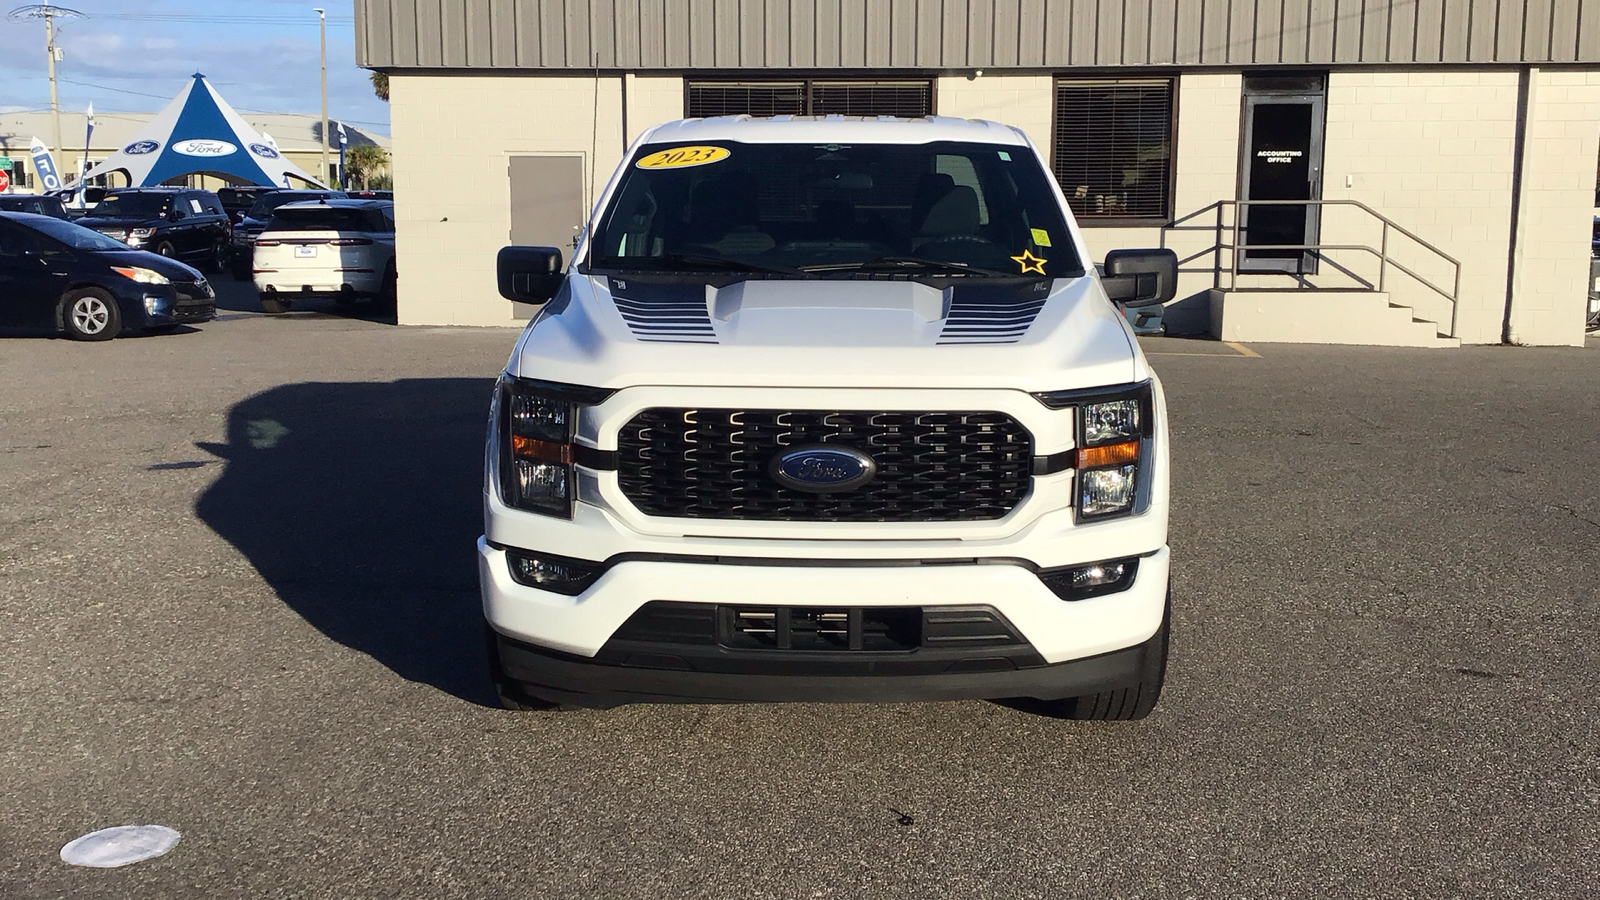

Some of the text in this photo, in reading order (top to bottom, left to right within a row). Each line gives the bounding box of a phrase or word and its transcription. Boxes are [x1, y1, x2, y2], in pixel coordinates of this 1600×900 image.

[128, 141, 156, 155] Ford
[186, 142, 224, 154] Ford
[254, 143, 275, 158] Ford
[649, 148, 716, 167] 2023
[798, 457, 848, 479] Ford
